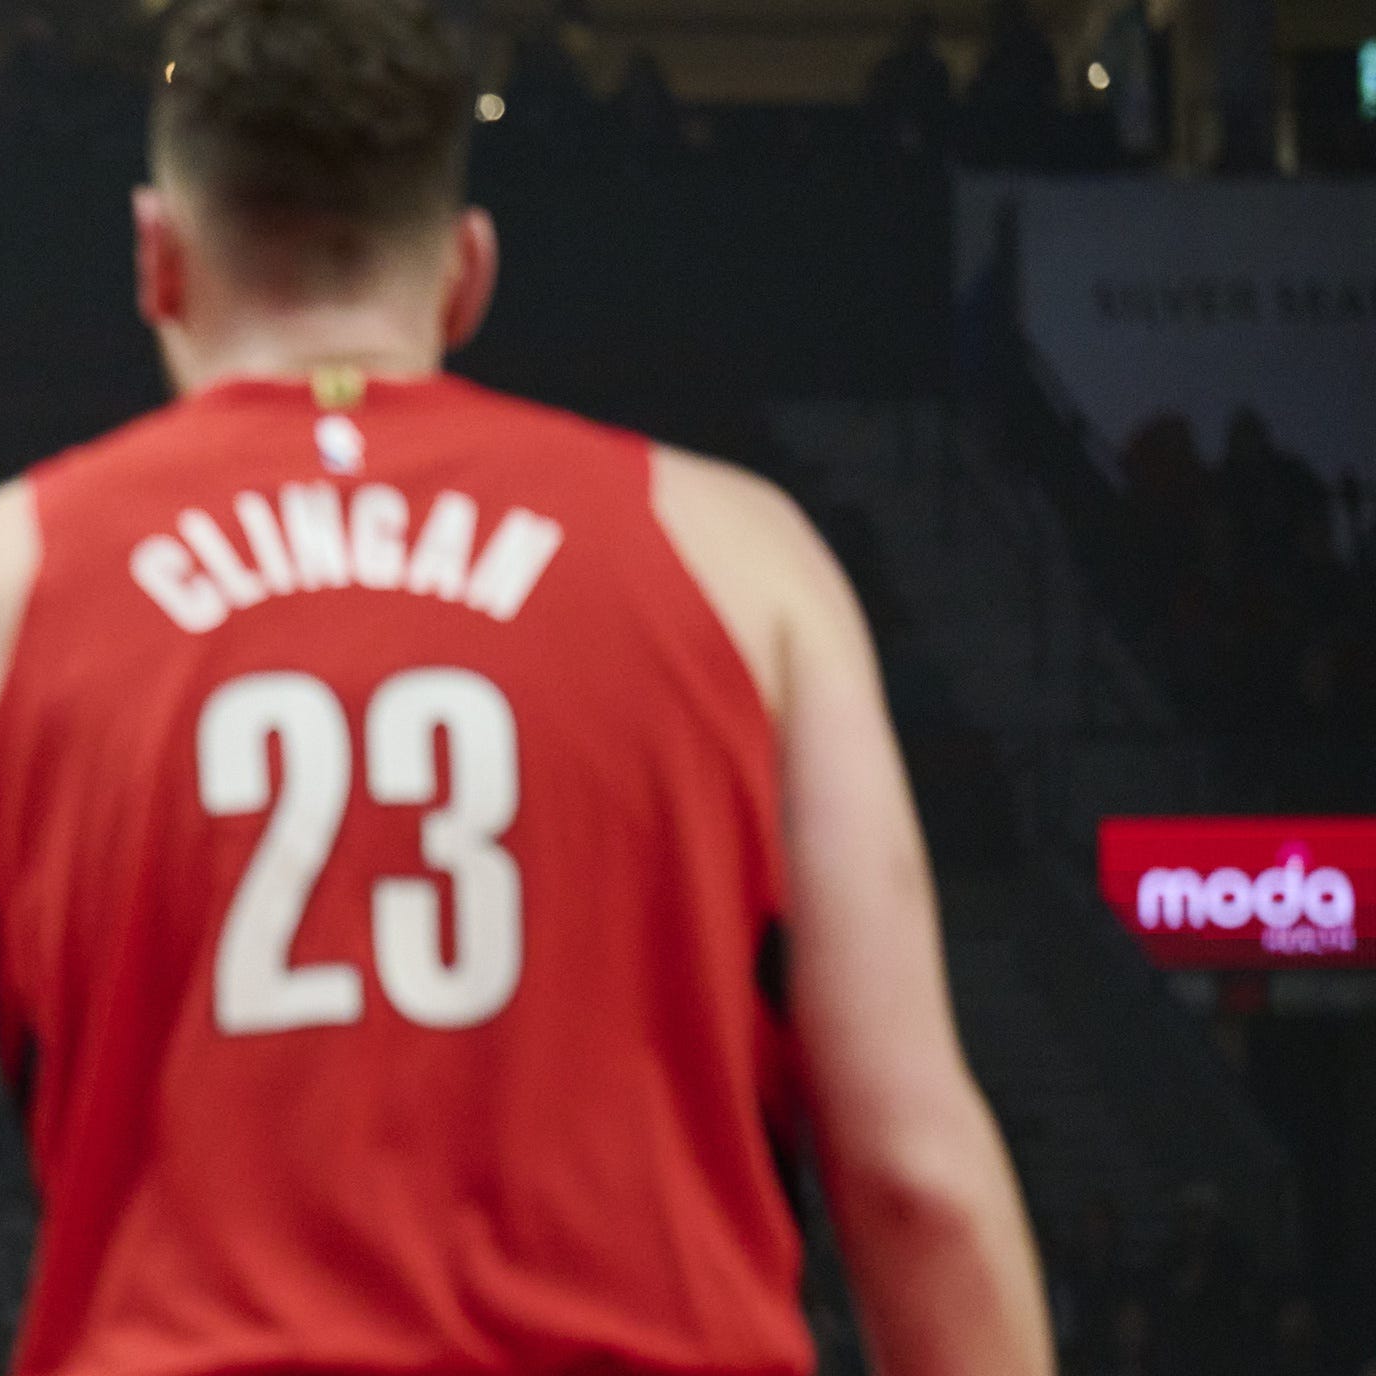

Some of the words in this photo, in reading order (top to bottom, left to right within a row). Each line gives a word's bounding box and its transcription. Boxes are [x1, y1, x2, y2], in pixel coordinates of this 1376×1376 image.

[128, 480, 565, 634] CLINGAN
[195, 663, 525, 1036] 23
[1136, 852, 1356, 931] moda
